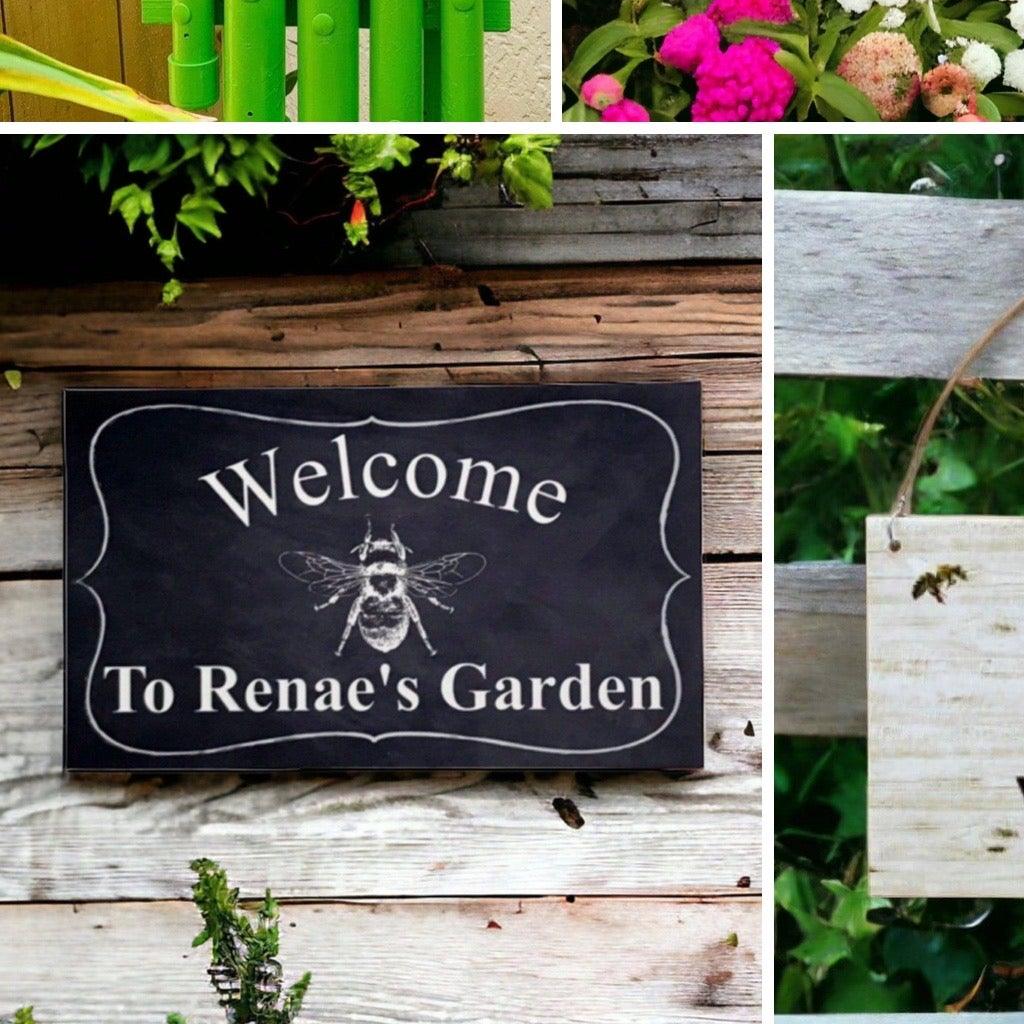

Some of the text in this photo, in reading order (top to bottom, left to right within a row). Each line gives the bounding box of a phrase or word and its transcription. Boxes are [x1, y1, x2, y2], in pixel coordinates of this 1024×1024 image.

[199, 434, 569, 528] Welcome
[103, 662, 664, 714] To Renae's Garden
